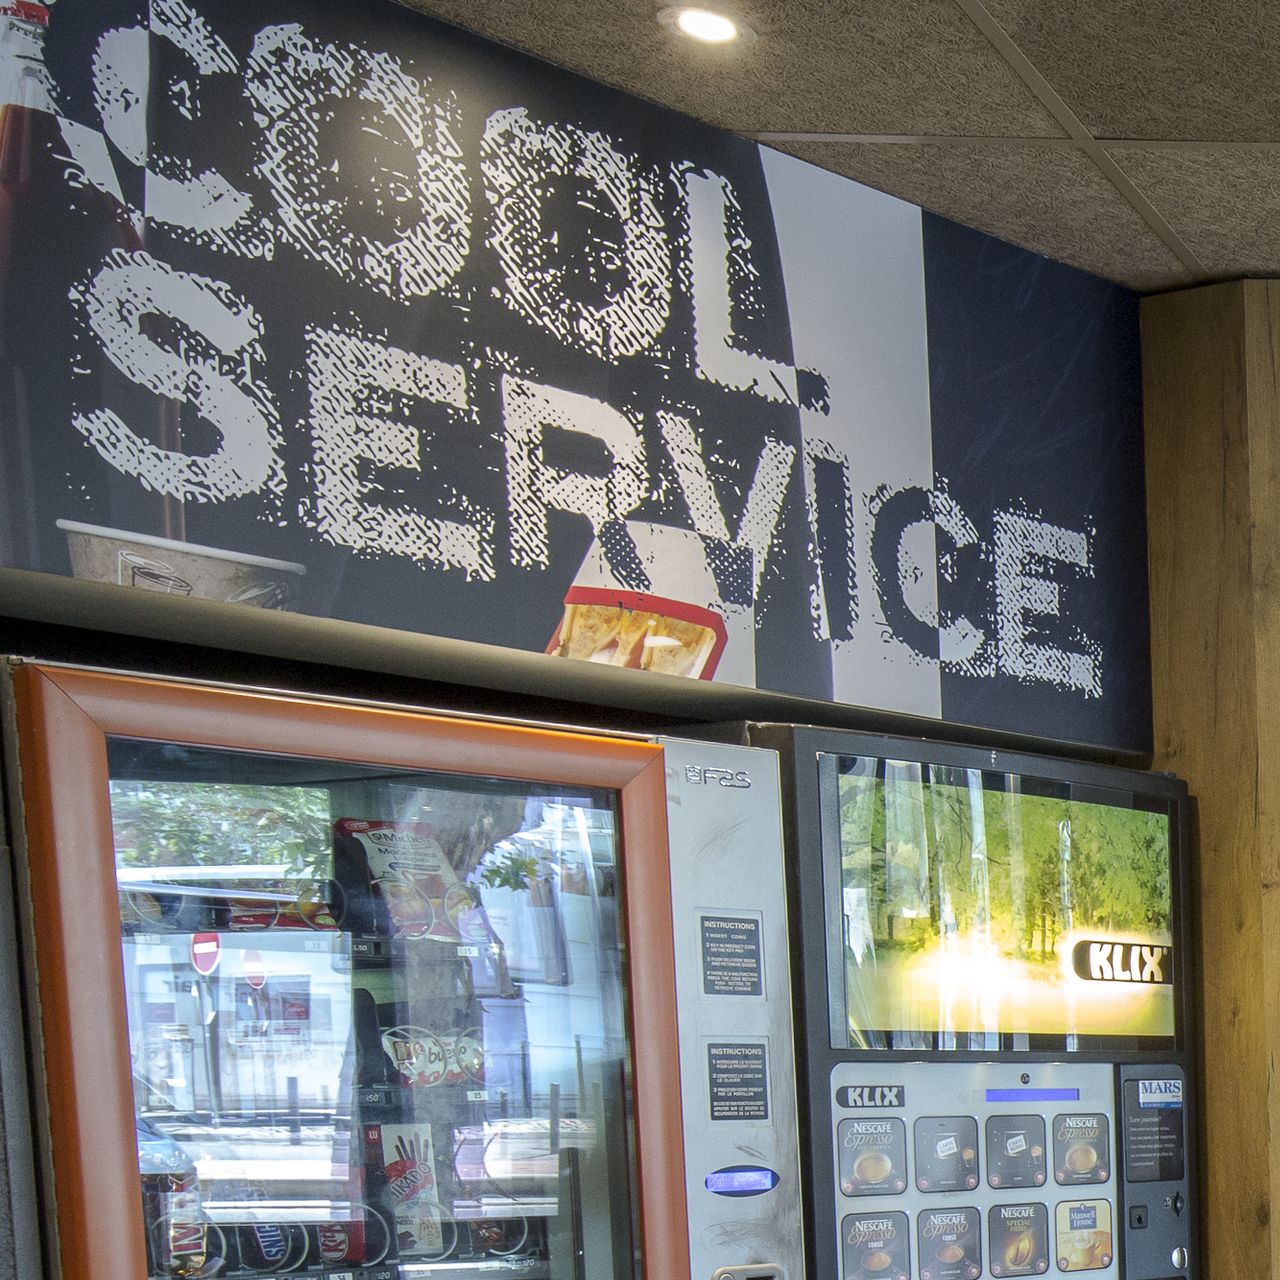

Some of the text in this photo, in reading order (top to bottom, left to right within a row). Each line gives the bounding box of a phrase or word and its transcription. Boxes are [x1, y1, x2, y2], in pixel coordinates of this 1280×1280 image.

[52, 0, 830, 413] COOL
[68, 246, 1103, 698] SERVICE
[703, 920, 756, 930] INSTRUCTIONS
[1089, 942, 1163, 982] KLIX
[710, 1047, 762, 1055] INSTRUCTIONS
[1141, 1081, 1181, 1094] MARS
[847, 1087, 899, 1107] KLIX
[853, 1121, 893, 1134] NESCAFÉ
[1066, 1117, 1098, 1128] NESCAFÉ
[844, 1129, 893, 1152] Espresso
[930, 1212, 967, 1225] NESCAFÉ
[1001, 1206, 1036, 1218] NESCAFÉ
[855, 1218, 894, 1232] NESCAFÉ
